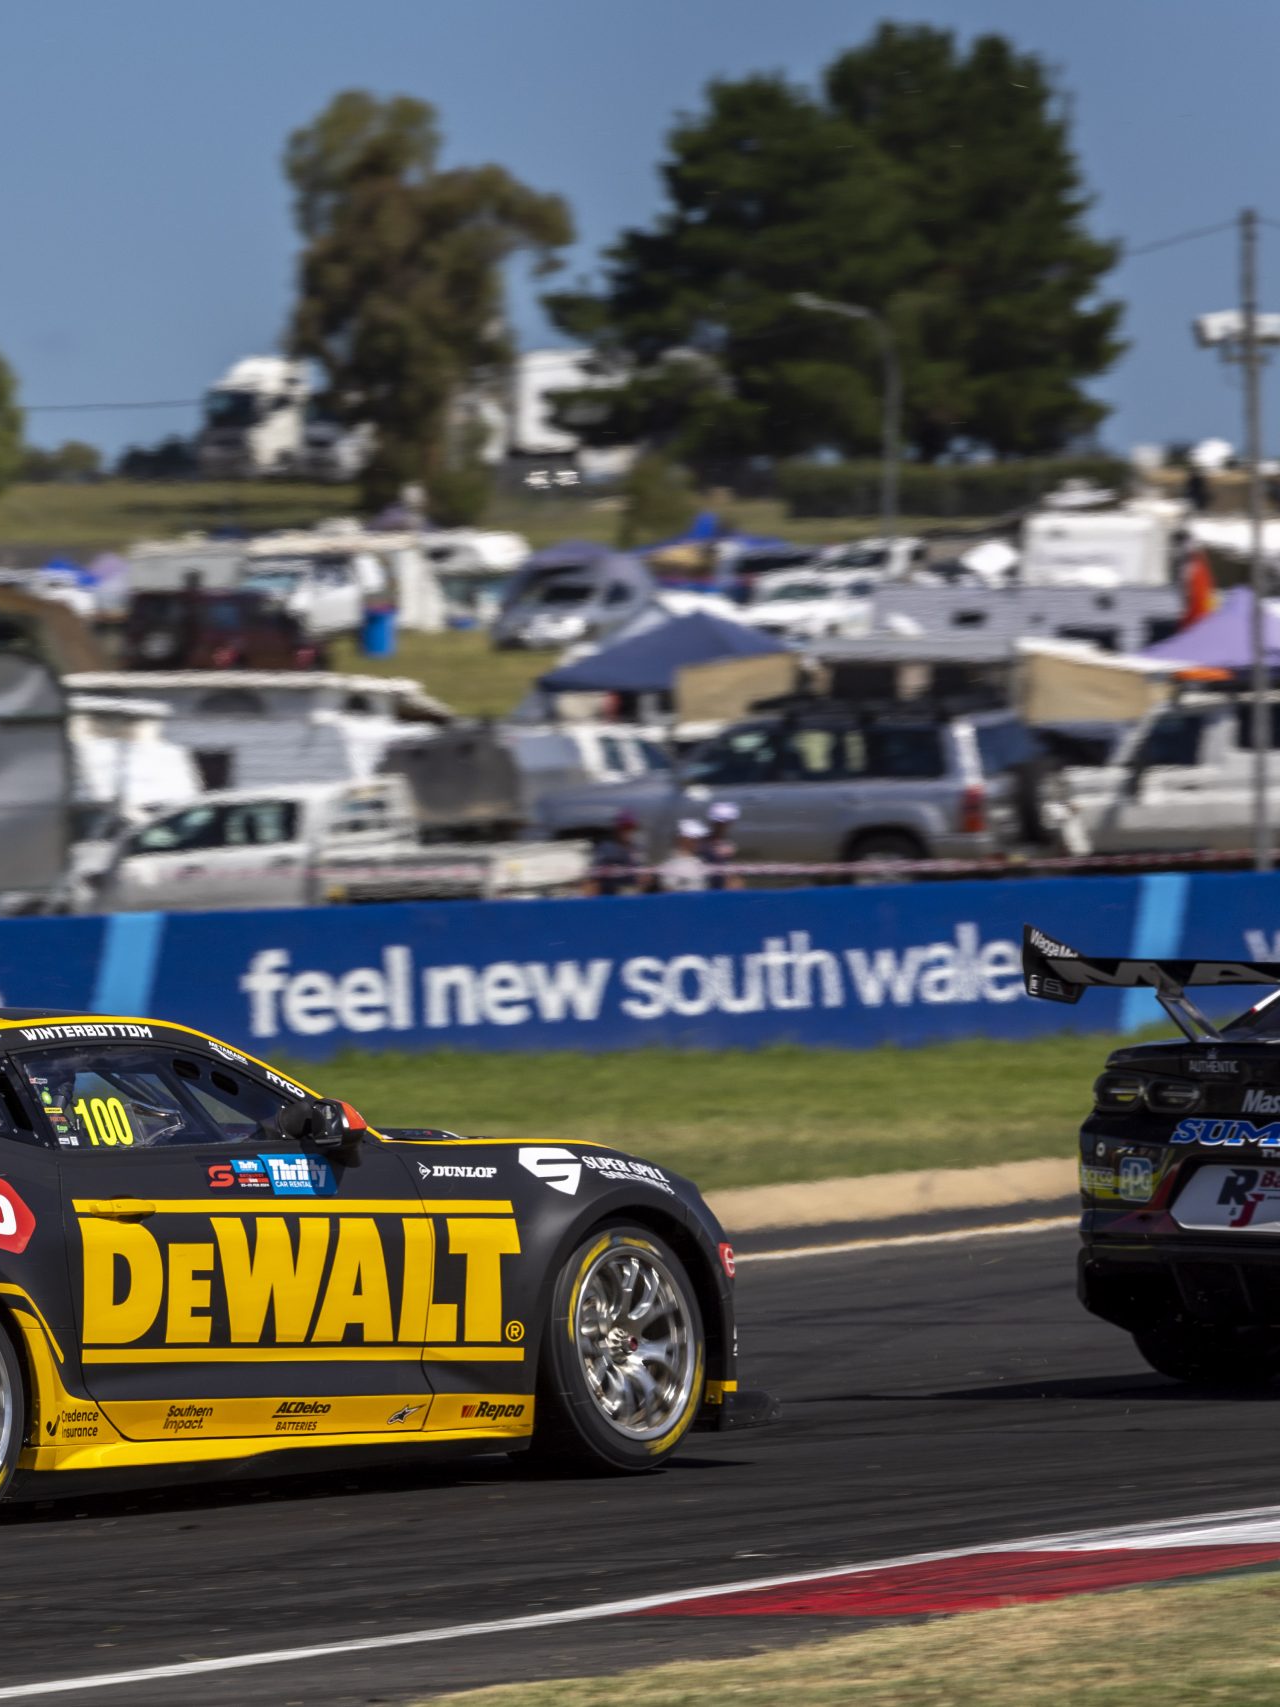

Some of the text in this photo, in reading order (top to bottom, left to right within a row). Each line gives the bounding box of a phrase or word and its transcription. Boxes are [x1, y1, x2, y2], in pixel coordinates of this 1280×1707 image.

[241, 922, 1024, 1038] feel new south wale
[20, 1023, 153, 1041] WINTERBOTTOM
[1188, 1060, 1240, 1074] AUTHENTIC
[266, 1070, 306, 1099] RYCO
[74, 1096, 135, 1147] 100
[432, 1165, 497, 1178] DUNLOP
[581, 1155, 670, 1183] SUPER SPILL
[167, 1404, 213, 1418] Southern
[275, 1401, 331, 1414] ACDelco
[475, 1401, 524, 1421] Repco
[61, 1408, 99, 1423] Credence
[61, 1424, 99, 1439] Insurance
[275, 1421, 318, 1431] BATTERIES
